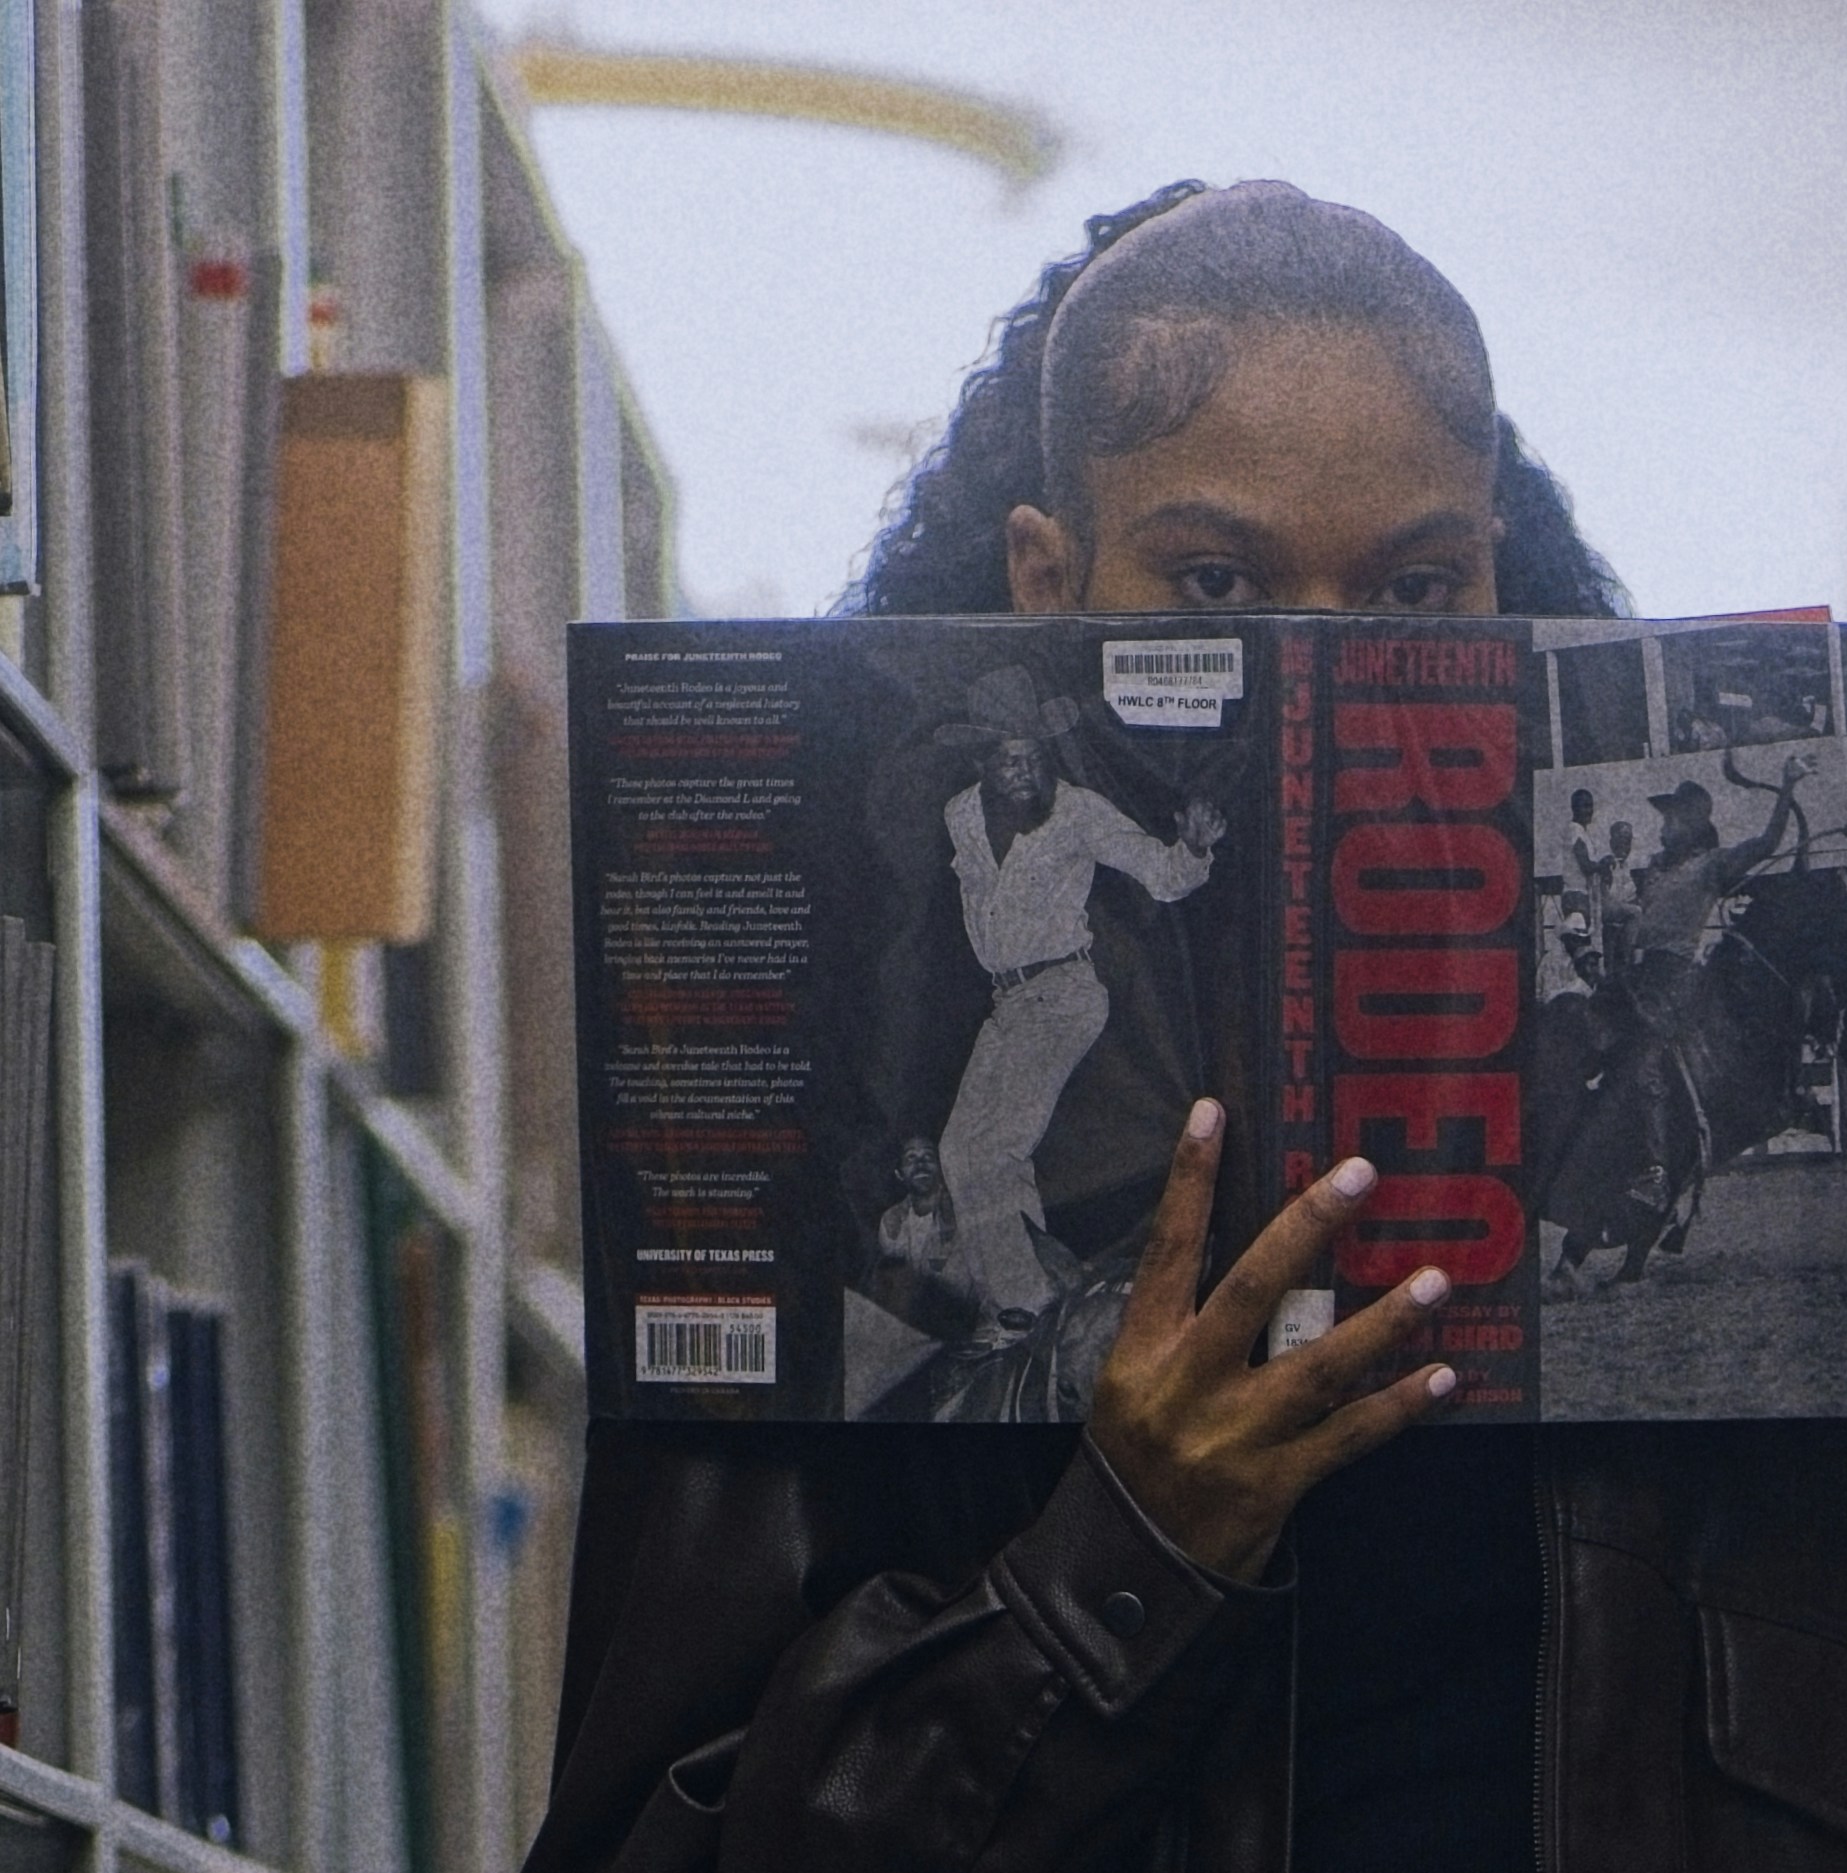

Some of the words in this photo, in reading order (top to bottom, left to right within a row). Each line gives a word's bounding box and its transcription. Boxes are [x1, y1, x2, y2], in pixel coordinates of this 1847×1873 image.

[625, 652, 660, 661] PRAISE
[661, 652, 682, 661] FOR
[683, 652, 748, 661] JUNETEENTH
[749, 651, 782, 661] RODEO
[1332, 639, 1519, 688] JUNETEENTH
[681, 682, 714, 693] Rodeo
[714, 682, 724, 693] is
[724, 685, 732, 693] a
[732, 684, 766, 696] joyous
[767, 682, 788, 693] and
[763, 699, 800, 711] history
[1117, 695, 1154, 708] HWLC
[1177, 697, 1217, 710] FLOOR
[716, 714, 752, 725] known
[753, 716, 764, 725] to
[644, 779, 677, 791] photos
[719, 777, 735, 788] the
[736, 778, 764, 791] great
[765, 777, 795, 788] times
[637, 810, 650, 820] to
[650, 810, 665, 820] the
[688, 809, 715, 822] after
[717, 810, 733, 820] the
[1332, 702, 1526, 1287] RODEO
[669, 1171, 702, 1183] photos
[703, 1174, 720, 1182] are
[651, 1187, 670, 1198] The
[697, 1187, 707, 1198] is
[636, 1248, 693, 1262] UNIVERSITY
[694, 1248, 707, 1262] OF
[708, 1249, 740, 1262] TEXAS
[742, 1250, 775, 1262] PRESS
[639, 1296, 661, 1304] TEXAS
[717, 1296, 740, 1304] BLACK
[742, 1296, 772, 1305] STUDIES
[1284, 1323, 1301, 1333] GV
[1441, 1323, 1525, 1352] BIRD
